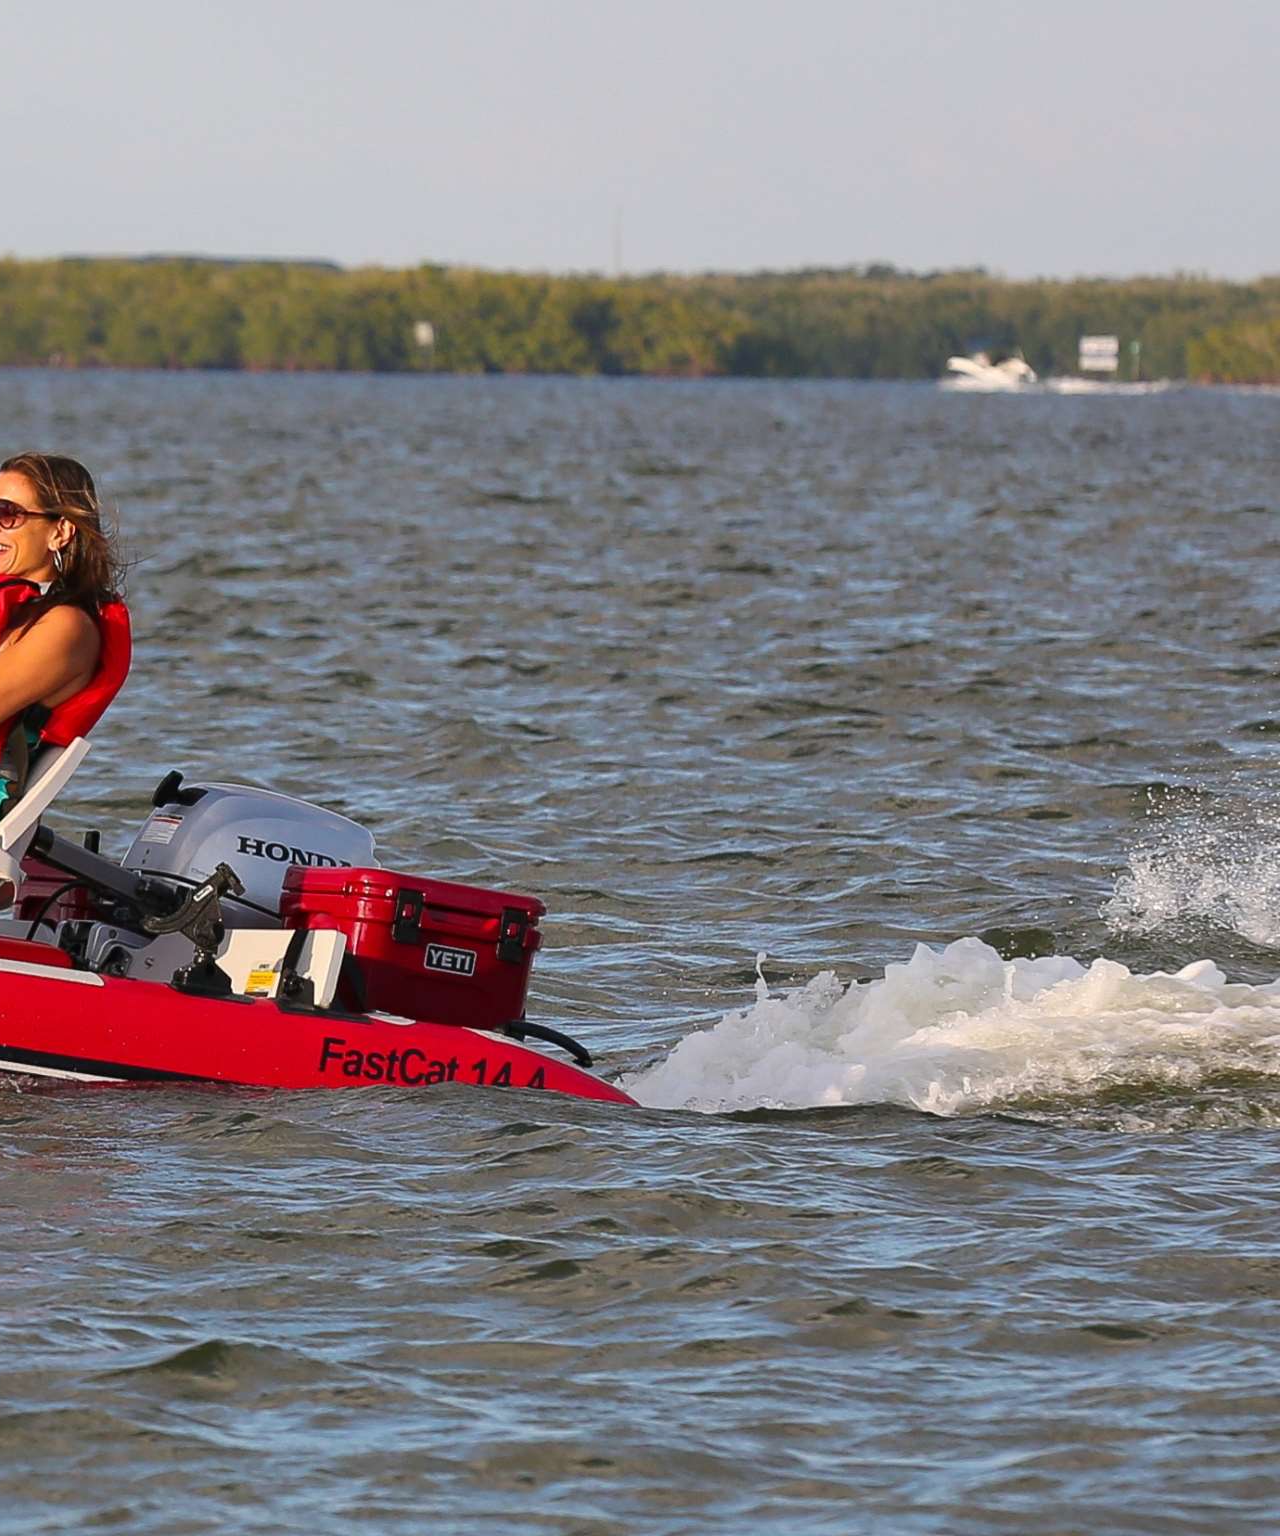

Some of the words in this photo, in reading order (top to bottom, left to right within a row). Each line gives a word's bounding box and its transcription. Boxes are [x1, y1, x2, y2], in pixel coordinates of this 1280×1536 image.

[430, 949, 471, 970] YETI
[319, 1037, 459, 1084] FastCat
[472, 1057, 545, 1089] 144
